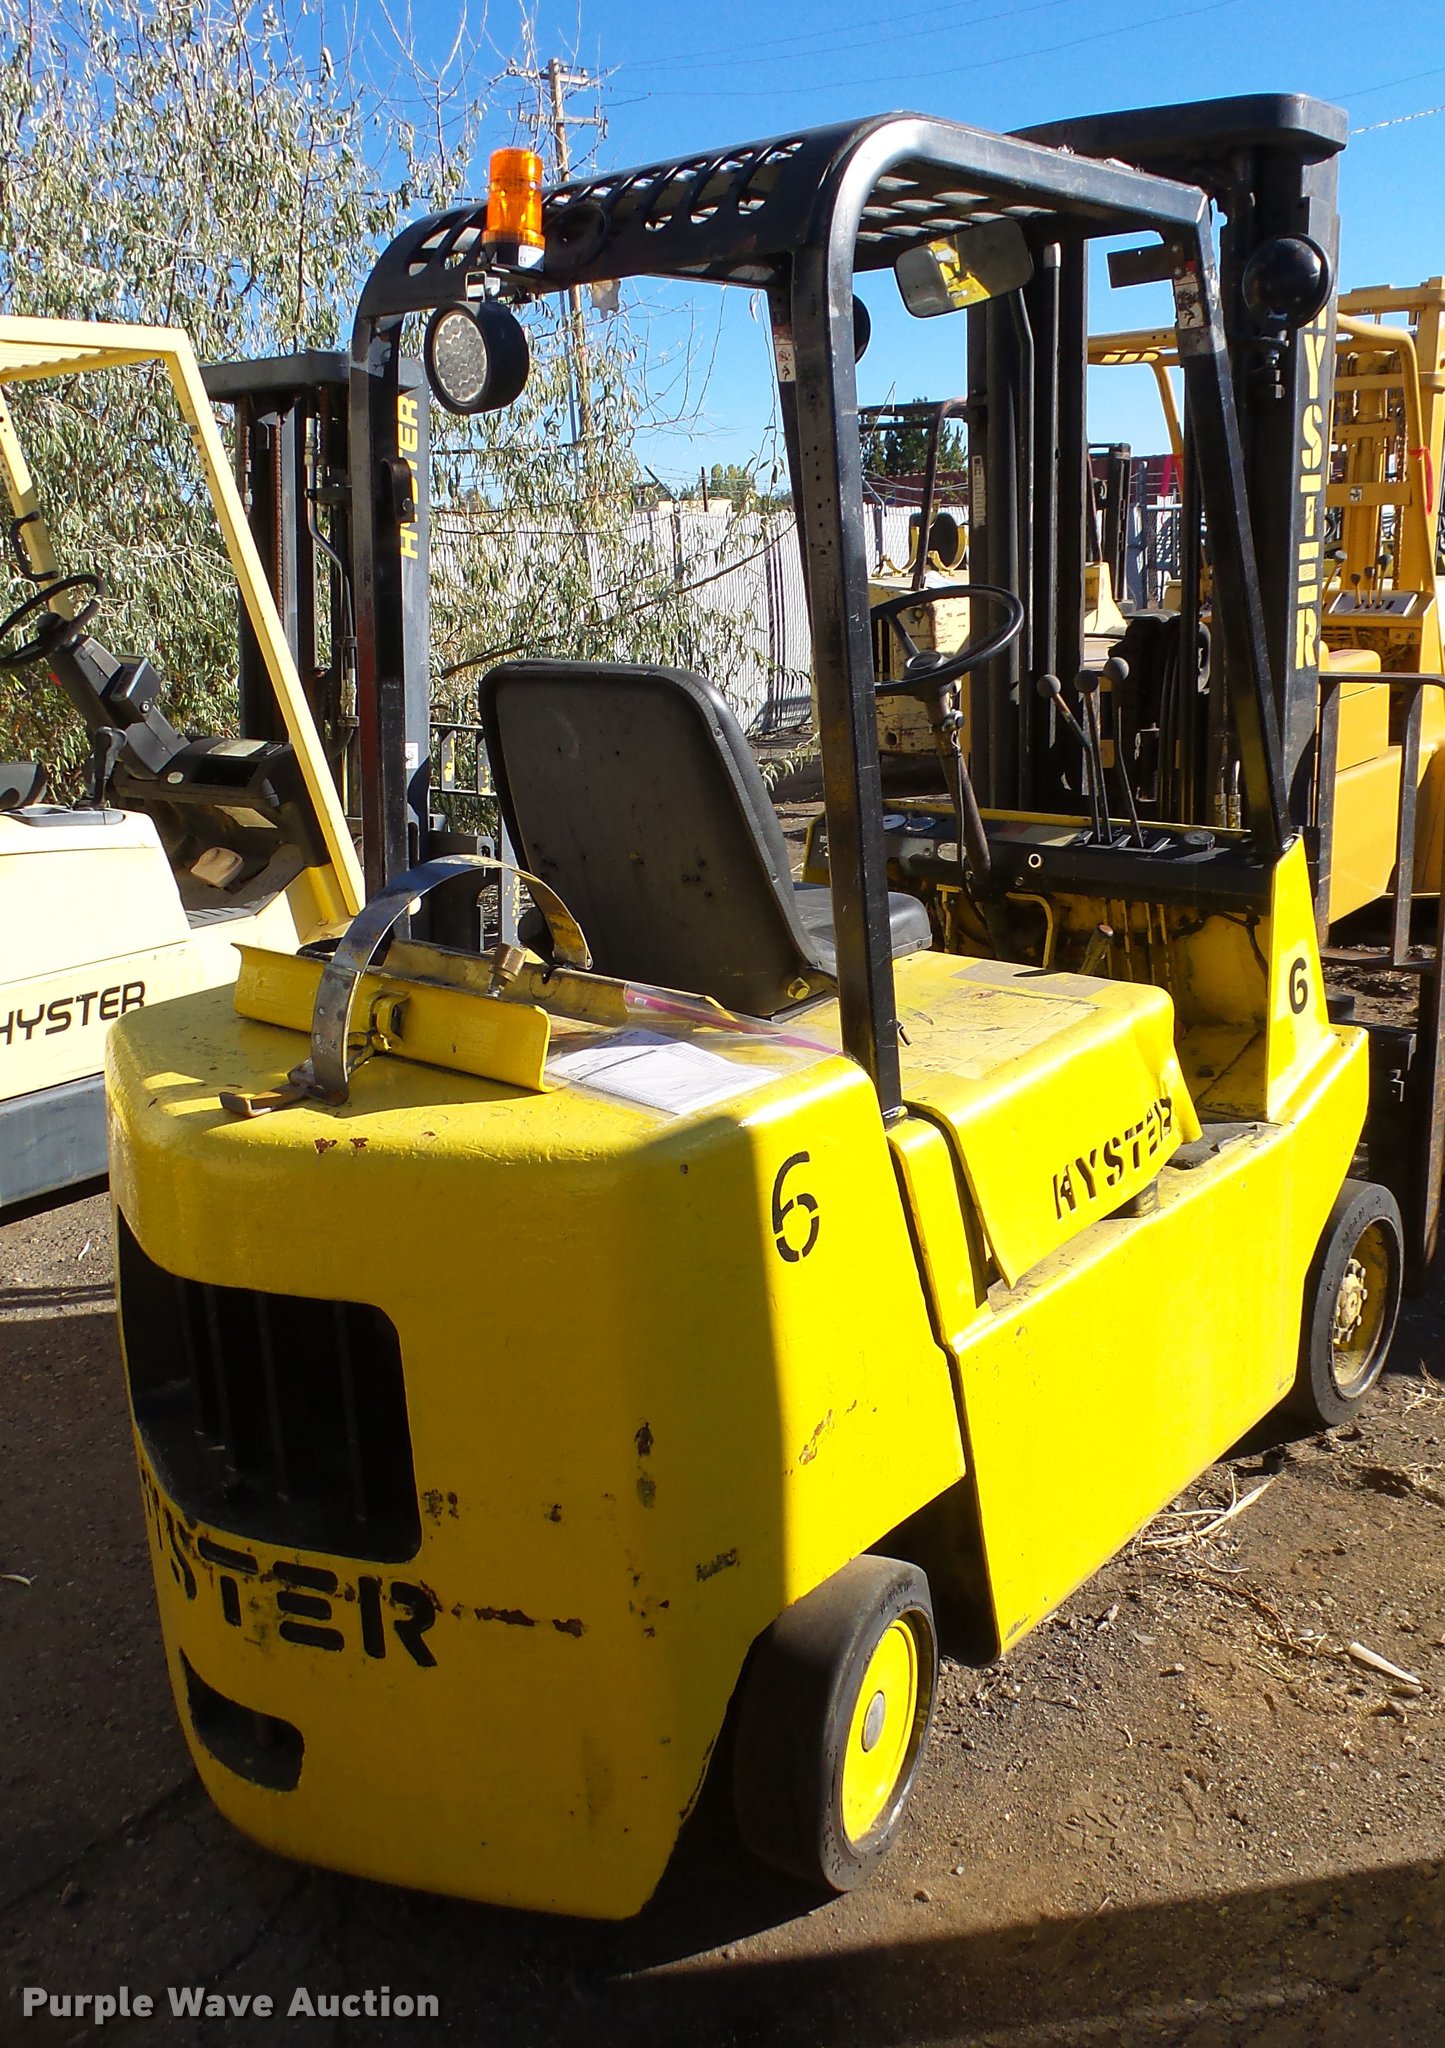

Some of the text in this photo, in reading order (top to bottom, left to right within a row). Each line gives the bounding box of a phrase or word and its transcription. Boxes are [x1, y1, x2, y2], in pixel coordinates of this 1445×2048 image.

[398, 395, 419, 559] HER
[1289, 957, 1308, 1014] 6
[772, 1151, 820, 1263] 6
[141, 1466, 438, 1668] STER
